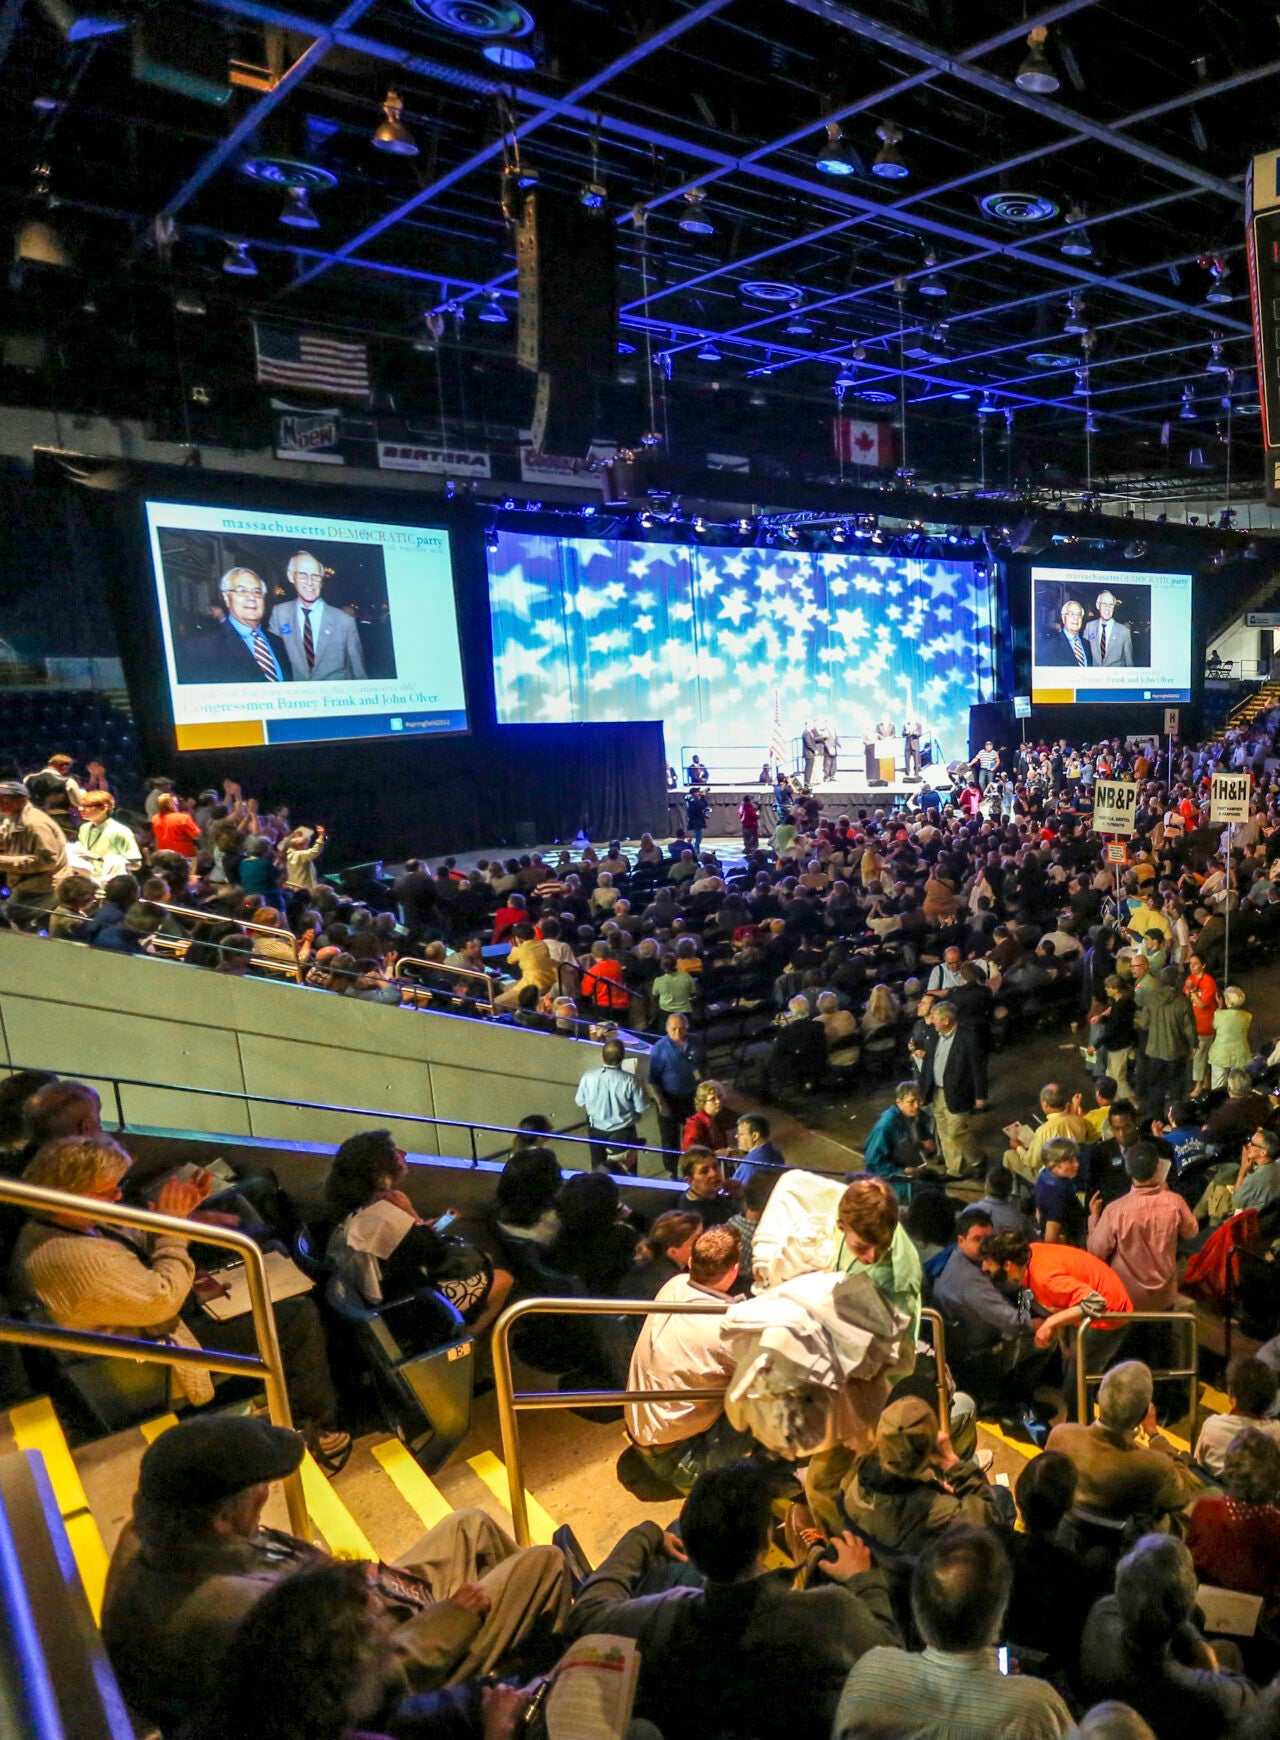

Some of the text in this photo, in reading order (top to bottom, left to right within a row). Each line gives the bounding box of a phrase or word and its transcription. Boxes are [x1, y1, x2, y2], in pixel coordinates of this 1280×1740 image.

[276, 696, 318, 714] Barney
[322, 694, 357, 709] Frank
[359, 694, 379, 706] and
[381, 692, 406, 709] John
[408, 691, 440, 704] Olver
[1096, 786, 1135, 810] NB&P
[1212, 779, 1247, 800] 1H&H
